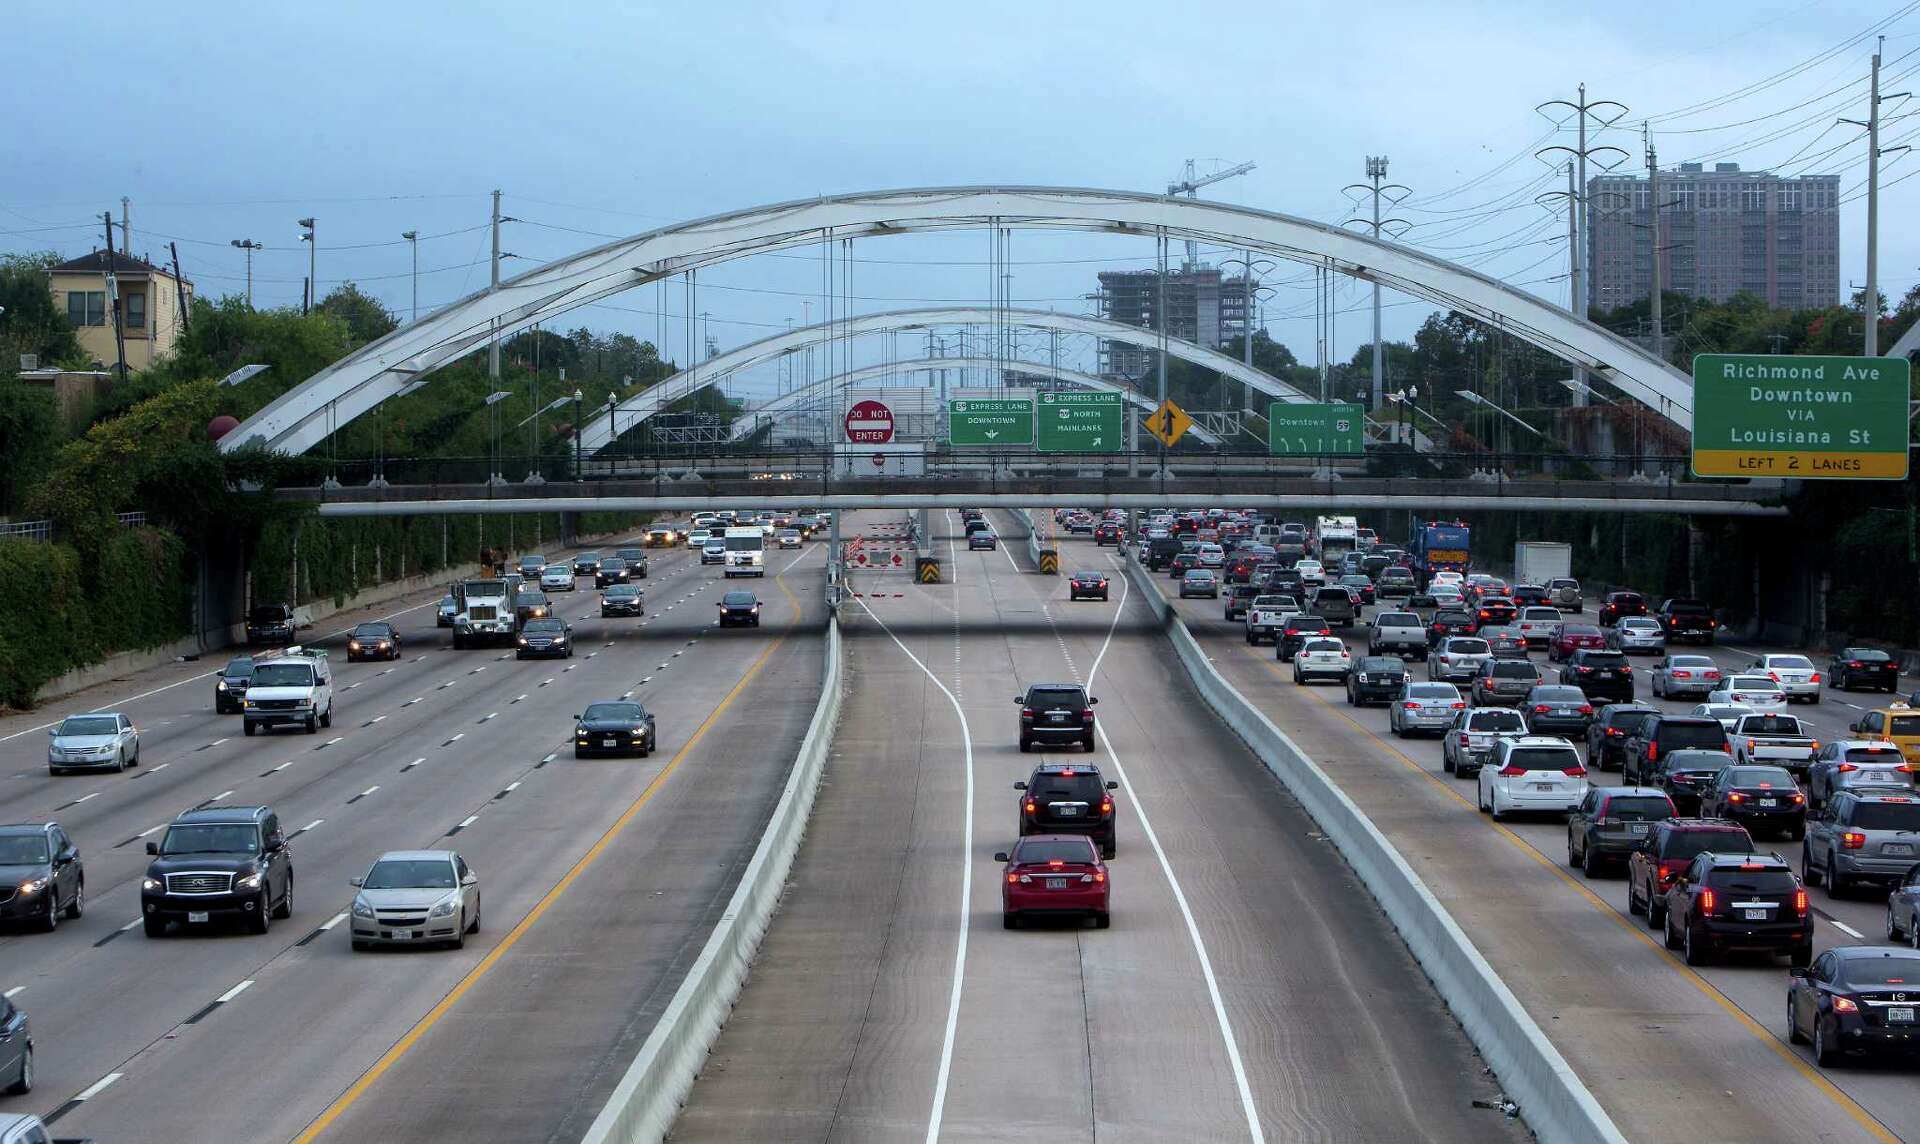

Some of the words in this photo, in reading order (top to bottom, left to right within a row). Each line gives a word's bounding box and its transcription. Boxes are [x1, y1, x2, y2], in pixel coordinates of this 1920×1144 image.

[1722, 363, 1825, 380] Richmond
[1842, 365, 1881, 380] Ave
[1058, 394, 1092, 402] EXPRESS
[1750, 387, 1853, 403] Downtown
[871, 410, 888, 418] NOT
[1787, 410, 1815, 422] VIA
[1279, 418, 1325, 426] Downtown
[856, 432, 884, 440] ENTER
[1731, 428, 1831, 444] Louisiana
[1849, 430, 1871, 444] St
[1738, 457, 1775, 469] LEFT
[1788, 456, 1800, 470] 2
[1812, 458, 1861, 470] LANES
